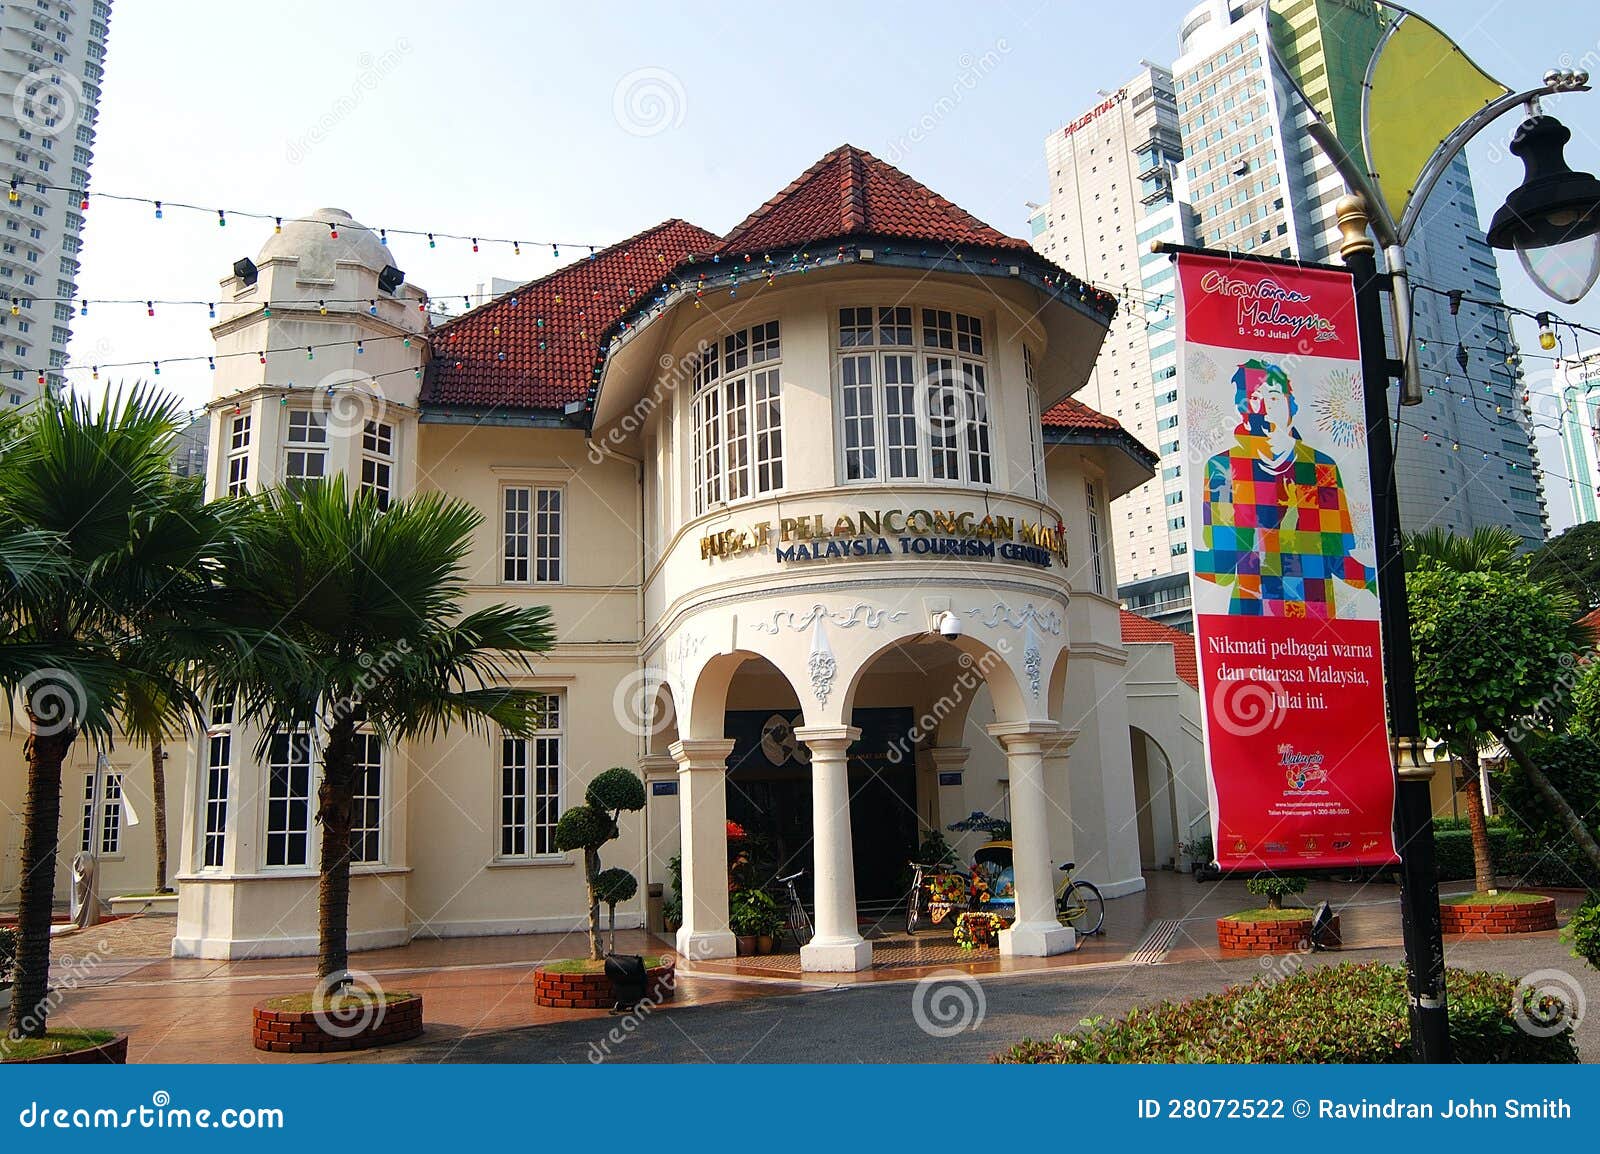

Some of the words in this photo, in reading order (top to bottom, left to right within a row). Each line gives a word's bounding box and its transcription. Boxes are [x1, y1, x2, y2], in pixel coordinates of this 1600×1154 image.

[1237, 296, 1336, 338] Malaysia
[1238, 328, 1245, 336] 8
[1253, 329, 1265, 338] 30
[1267, 329, 1290, 340] Julai
[700, 521, 771, 561] PUSAT
[780, 509, 1015, 543] PELANCONGAN
[776, 537, 893, 563] MALAYSIA
[898, 537, 996, 558] TOURISM
[1000, 543, 1053, 568] CENTRE
[1208, 636, 1267, 655] Nikmati
[1270, 638, 1329, 662] pelbagai
[1331, 644, 1373, 658] warna
[1217, 663, 1245, 681] dan
[1249, 665, 1304, 682] citarasa
[1307, 665, 1369, 688] Malaysia,
[1269, 691, 1302, 713] Julai
[1306, 692, 1328, 710] ini.
